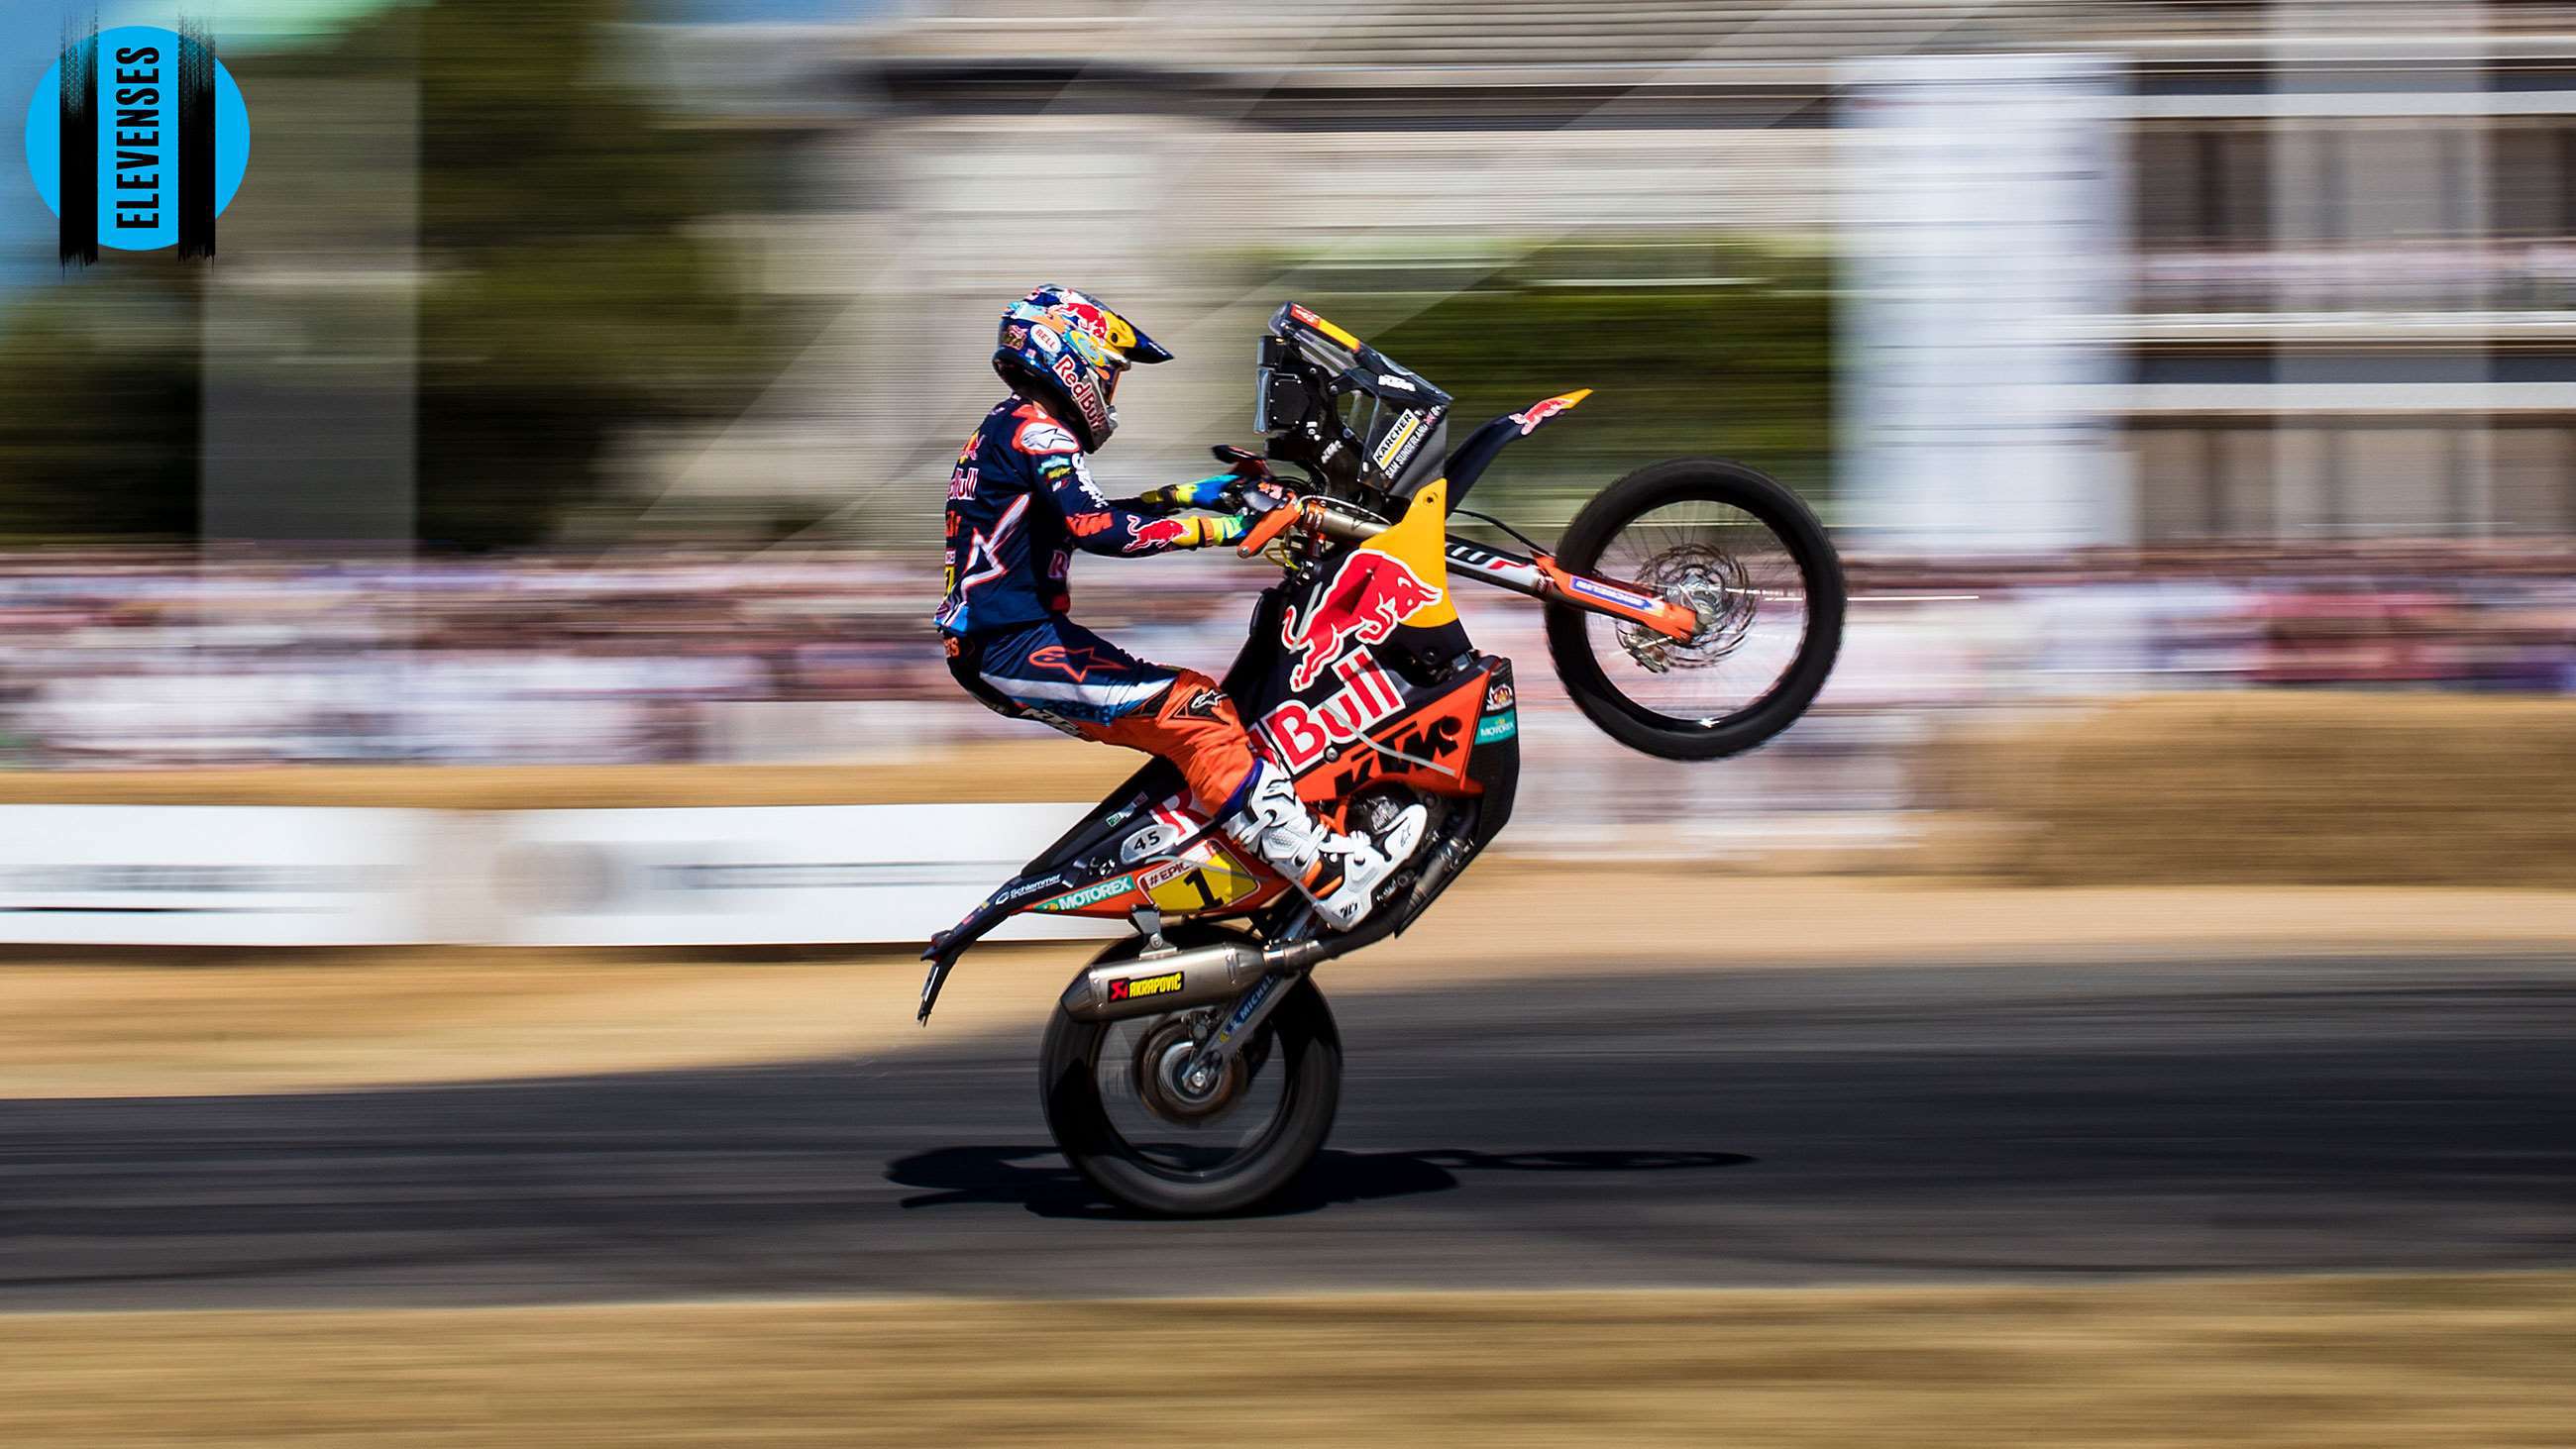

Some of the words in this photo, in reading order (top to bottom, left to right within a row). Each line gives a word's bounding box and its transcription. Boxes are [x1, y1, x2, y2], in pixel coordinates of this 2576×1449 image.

[1035, 328, 1056, 350] BELL
[1263, 648, 1403, 772] Bull
[1334, 715, 1462, 796] KTM
[1133, 830, 1160, 851] 45
[1010, 874, 1061, 898] Schlemmer
[1058, 877, 1132, 910] MOTOREX
[1183, 867, 1225, 911] 1
[1240, 975, 1276, 1020] MICHEL
